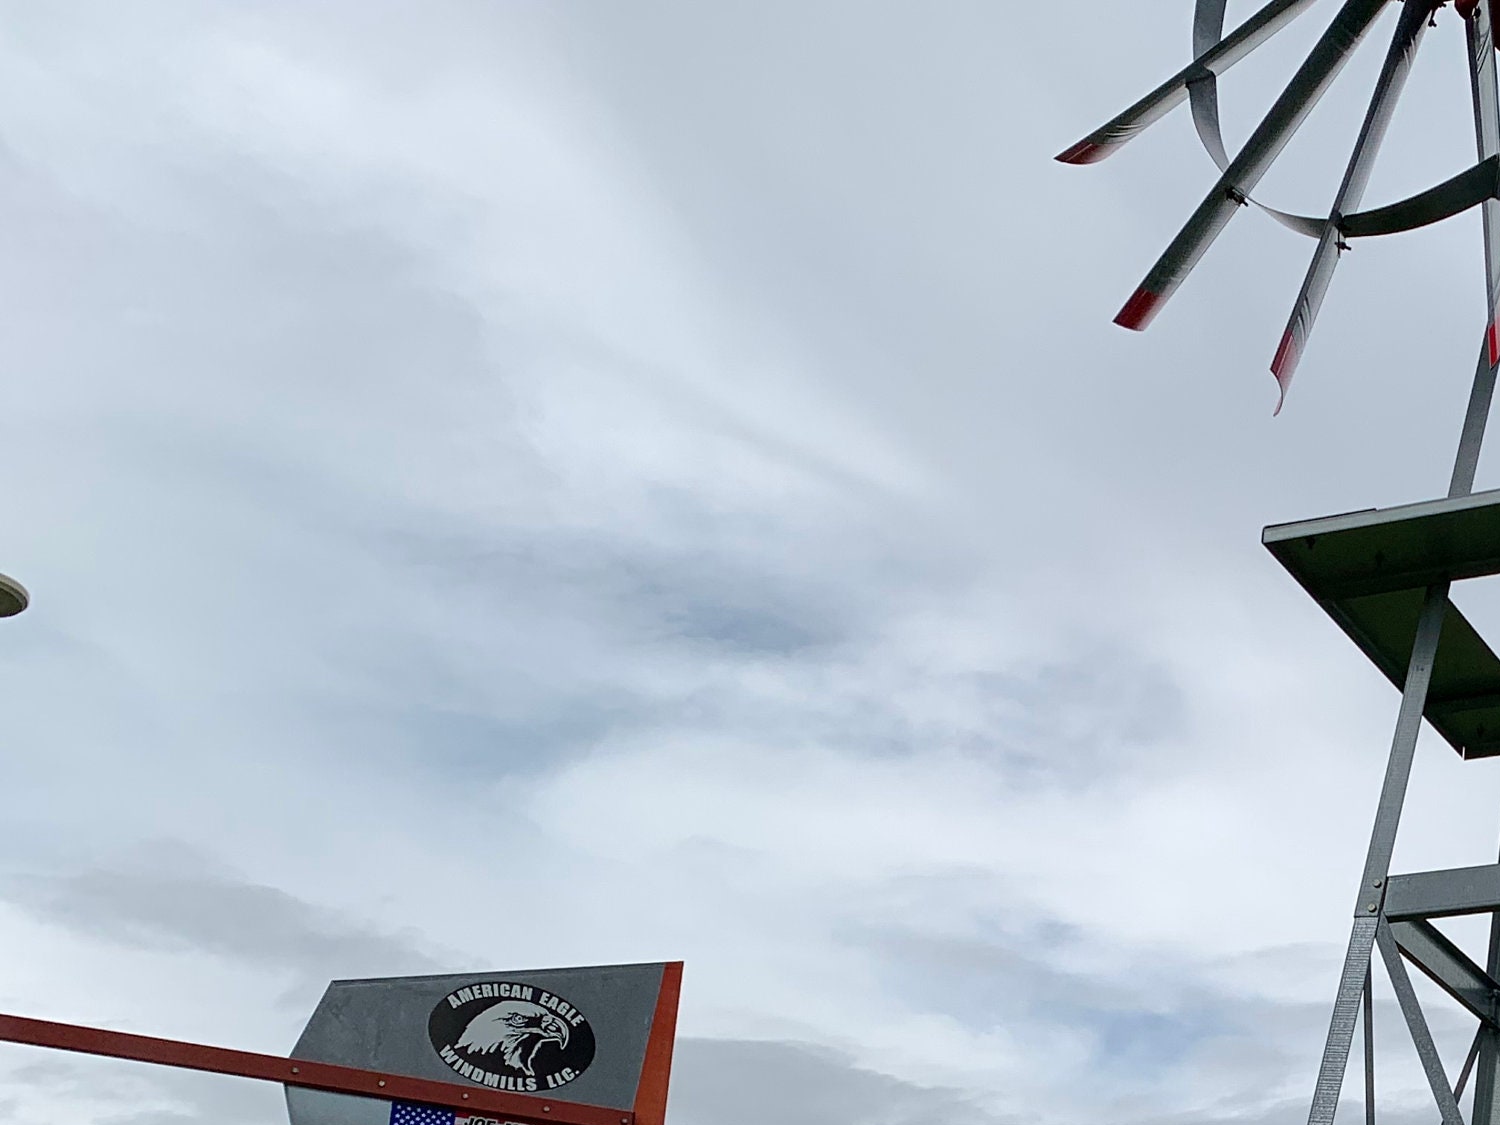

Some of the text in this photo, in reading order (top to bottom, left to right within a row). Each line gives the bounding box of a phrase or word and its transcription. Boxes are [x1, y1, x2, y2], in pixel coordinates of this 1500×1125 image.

[447, 983, 585, 1027] AMERICAN EAGLE
[439, 1044, 580, 1092] WINDMILLS LLC.
